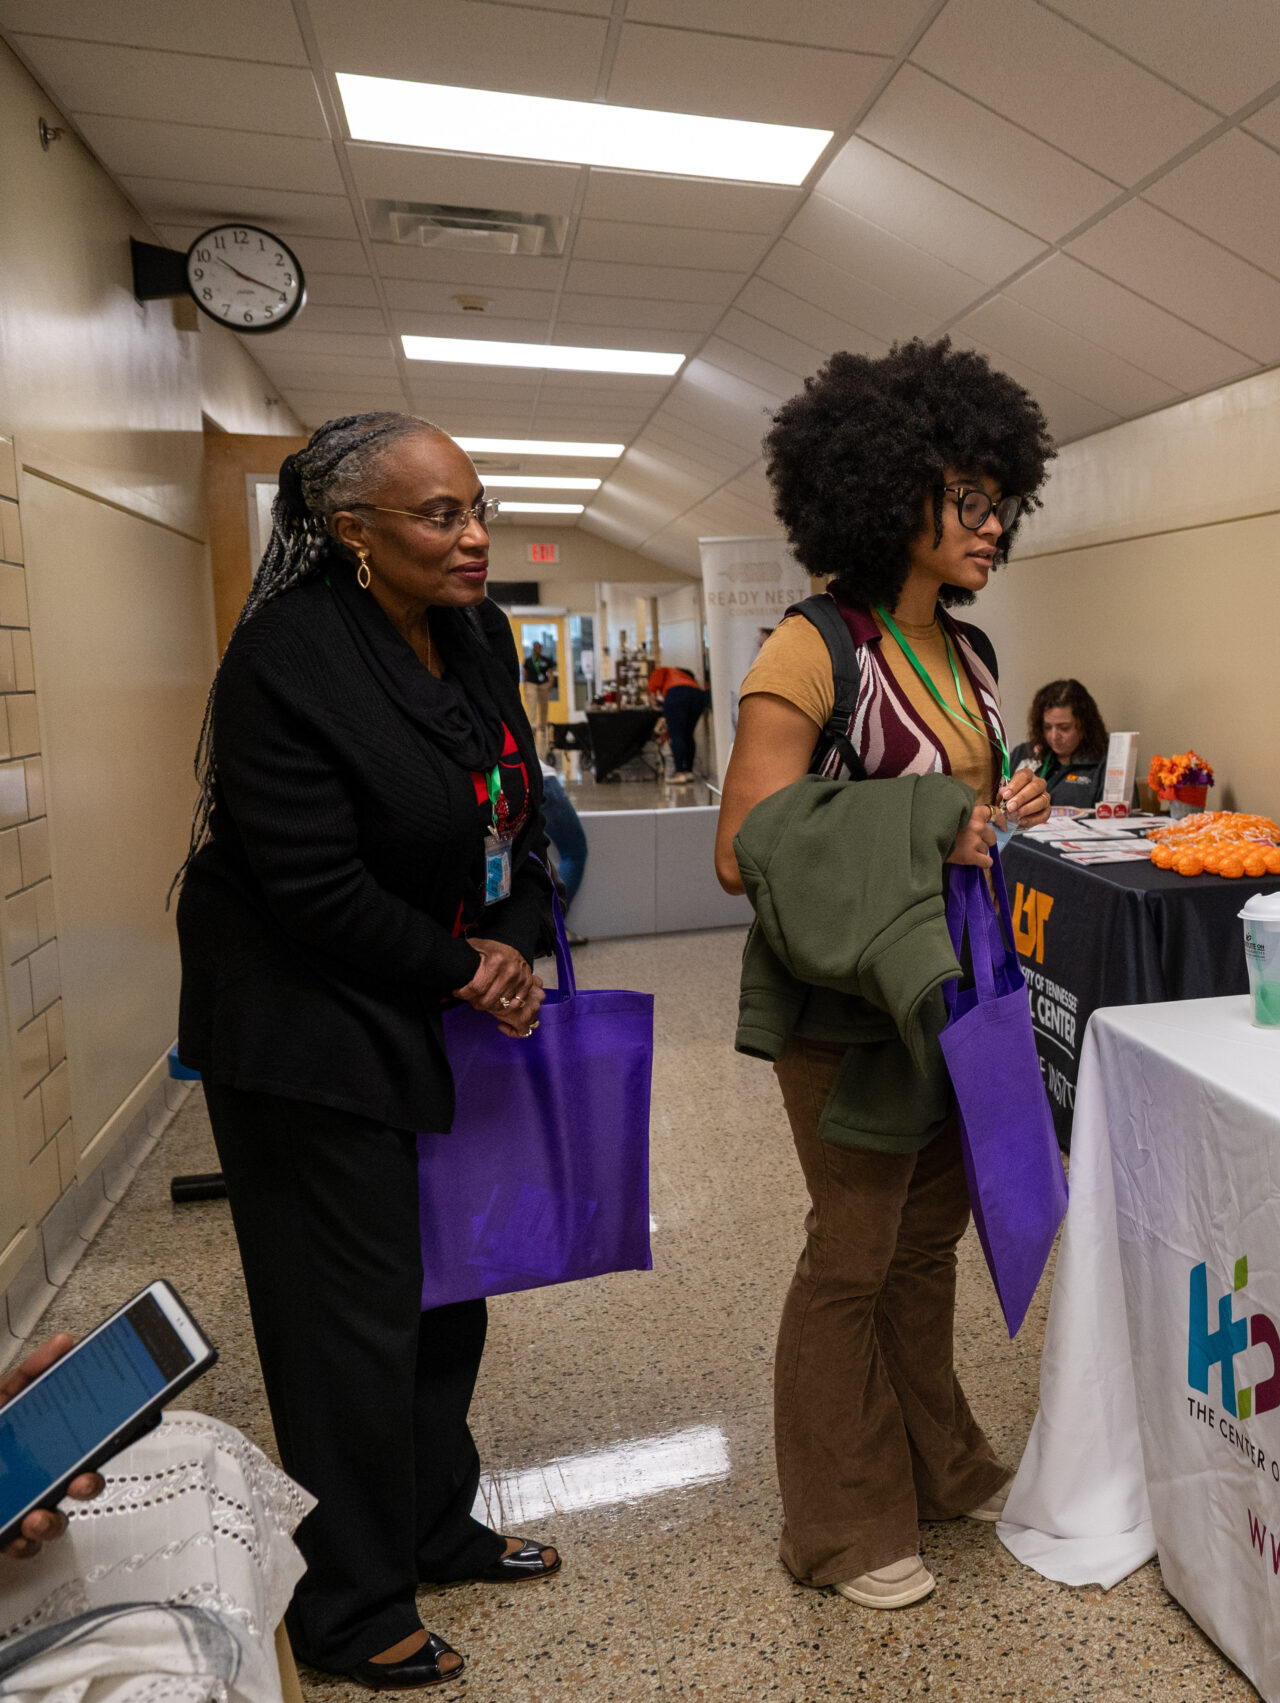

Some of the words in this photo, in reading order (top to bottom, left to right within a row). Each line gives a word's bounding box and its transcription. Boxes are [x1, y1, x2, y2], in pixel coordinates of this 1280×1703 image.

[214, 236, 226, 249] 11
[233, 231, 249, 244] 12
[259, 238, 265, 251] 1
[196, 248, 211, 263] 10
[274, 253, 285, 267] 2
[194, 268, 204, 281] 9
[284, 273, 292, 286] 3
[202, 287, 213, 300] 8
[279, 291, 287, 304] 4
[222, 304, 231, 317] 7
[244, 310, 253, 322] 6
[265, 306, 273, 318] 5
[531, 544, 555, 562] EXIT
[707, 592, 758, 606] READY
[765, 589, 806, 604] NEST
[1035, 973, 1045, 991] OF
[1045, 978, 1078, 1014] TENNESSEE
[1037, 994, 1076, 1048] CENTER
[1187, 1397, 1215, 1429] THE
[1219, 1418, 1266, 1472] CENTER
